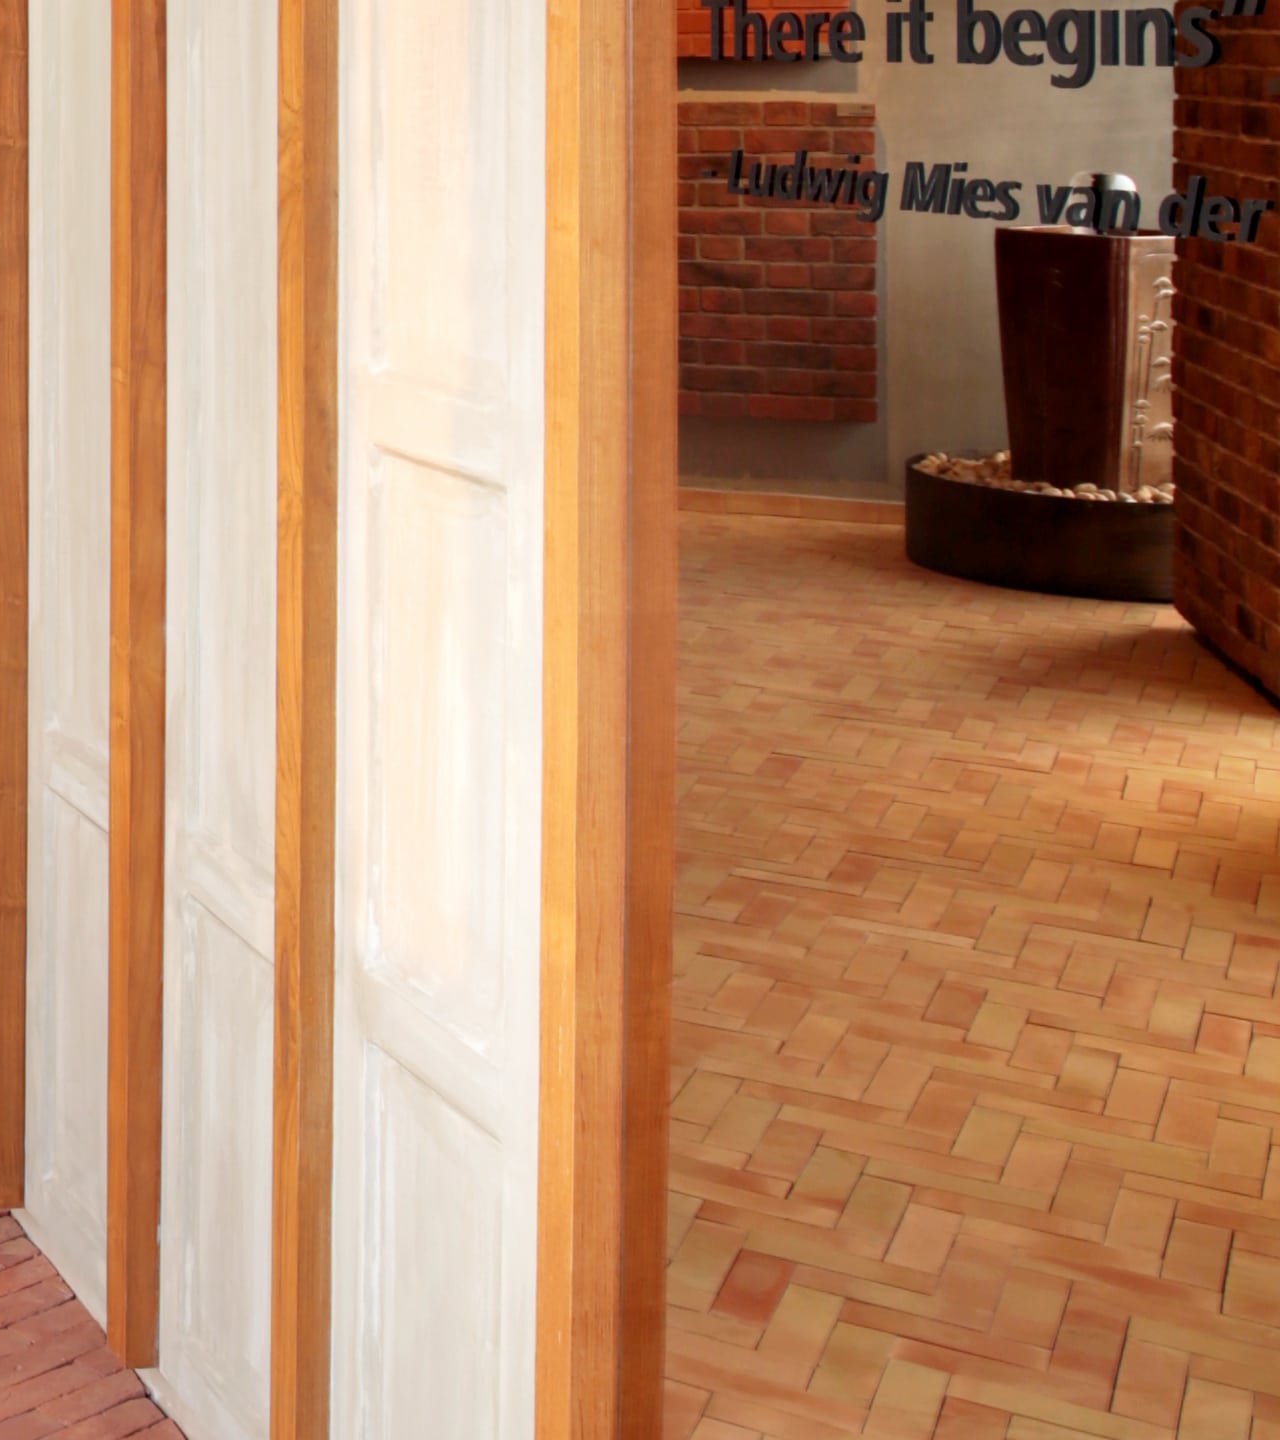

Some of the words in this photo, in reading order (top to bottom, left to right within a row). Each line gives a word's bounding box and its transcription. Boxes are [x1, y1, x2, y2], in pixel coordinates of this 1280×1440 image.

[727, 149, 889, 222] Ludwig
[900, 161, 1022, 221] Mies
[1037, 182, 1140, 234] van
[1158, 175, 1275, 243] der
